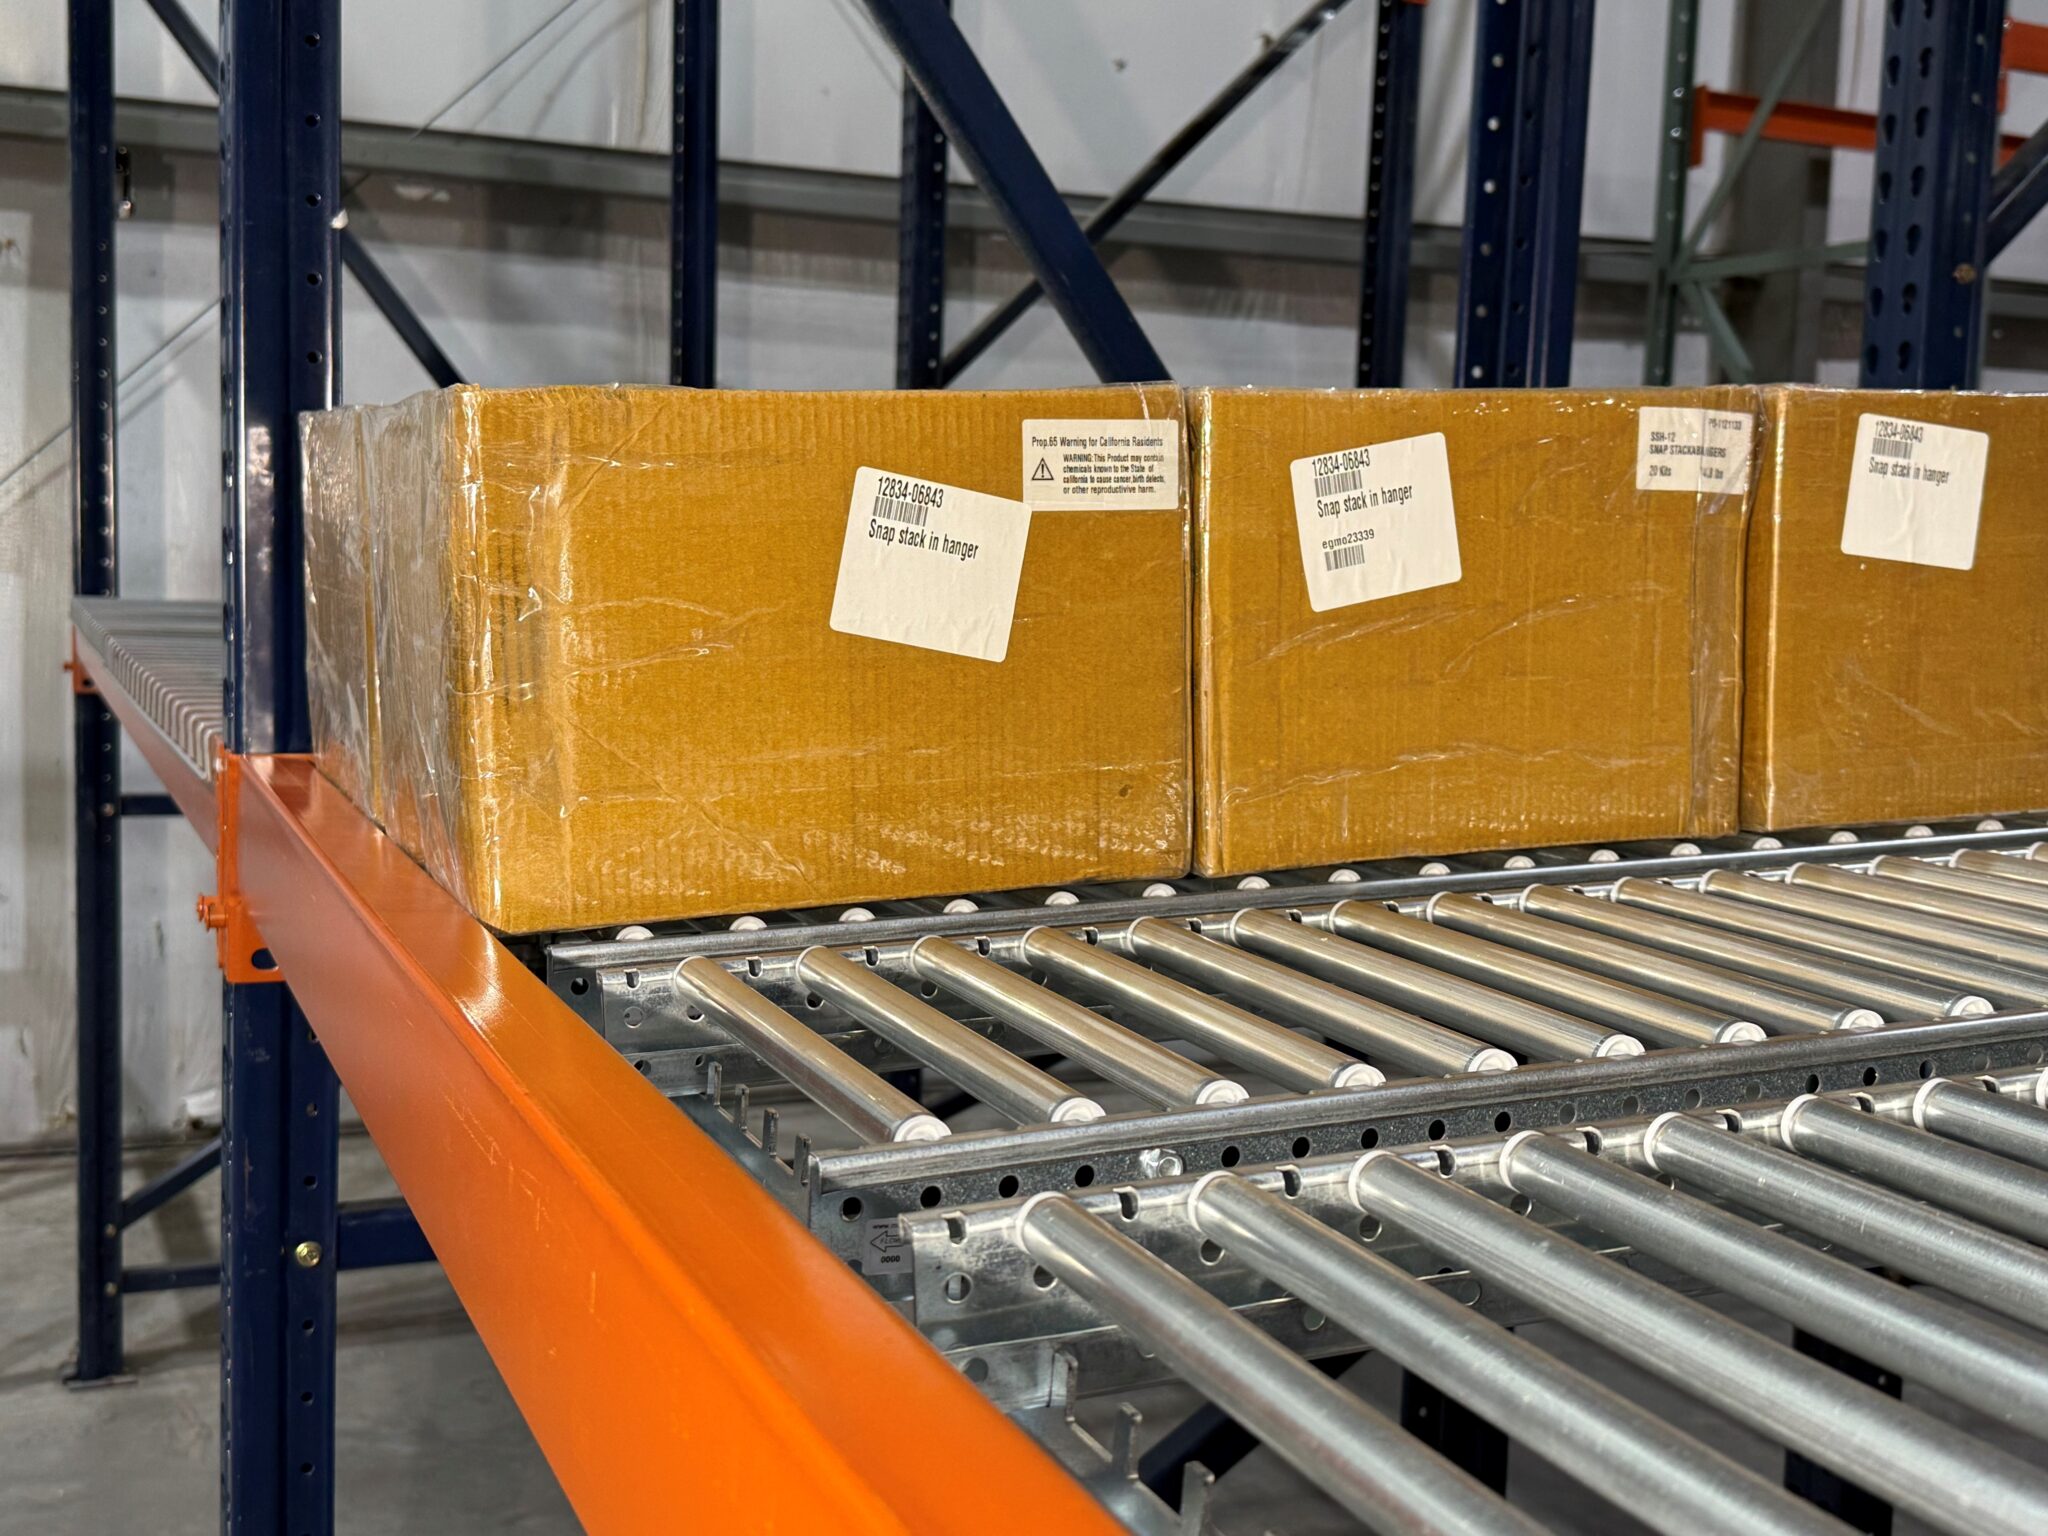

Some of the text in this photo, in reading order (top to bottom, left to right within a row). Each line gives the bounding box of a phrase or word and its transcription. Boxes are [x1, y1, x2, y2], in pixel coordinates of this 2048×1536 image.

[1650, 431, 1676, 442] SSH-12
[1875, 420, 1924, 443] 12834-06843
[1032, 436, 1058, 450] Prop.65
[1060, 436, 1087, 449] Warning
[1089, 436, 1098, 447] for
[1100, 436, 1130, 447] California
[1649, 444, 1668, 455] SNAP
[1094, 453, 1105, 463] This
[1107, 453, 1129, 463] Product
[1130, 455, 1142, 464] may
[1144, 454, 1164, 463] contain
[1311, 448, 1371, 477] 12834-06843
[1063, 463, 1154, 473] chemicals known to the State of
[1649, 465, 1658, 477] 20
[1868, 456, 1950, 487] Snap stack in hanger
[1063, 475, 1088, 484] california
[1090, 475, 1095, 484] to
[1096, 476, 1112, 484] cause
[878, 476, 944, 508] 12834-06843
[1063, 487, 1070, 495] or
[1072, 485, 1089, 495] other
[1138, 485, 1156, 494] harm.
[1317, 485, 1413, 519] Snap stack in hanger
[868, 518, 979, 561] Snap stack in hanger
[1322, 528, 1375, 550] egmo23339
